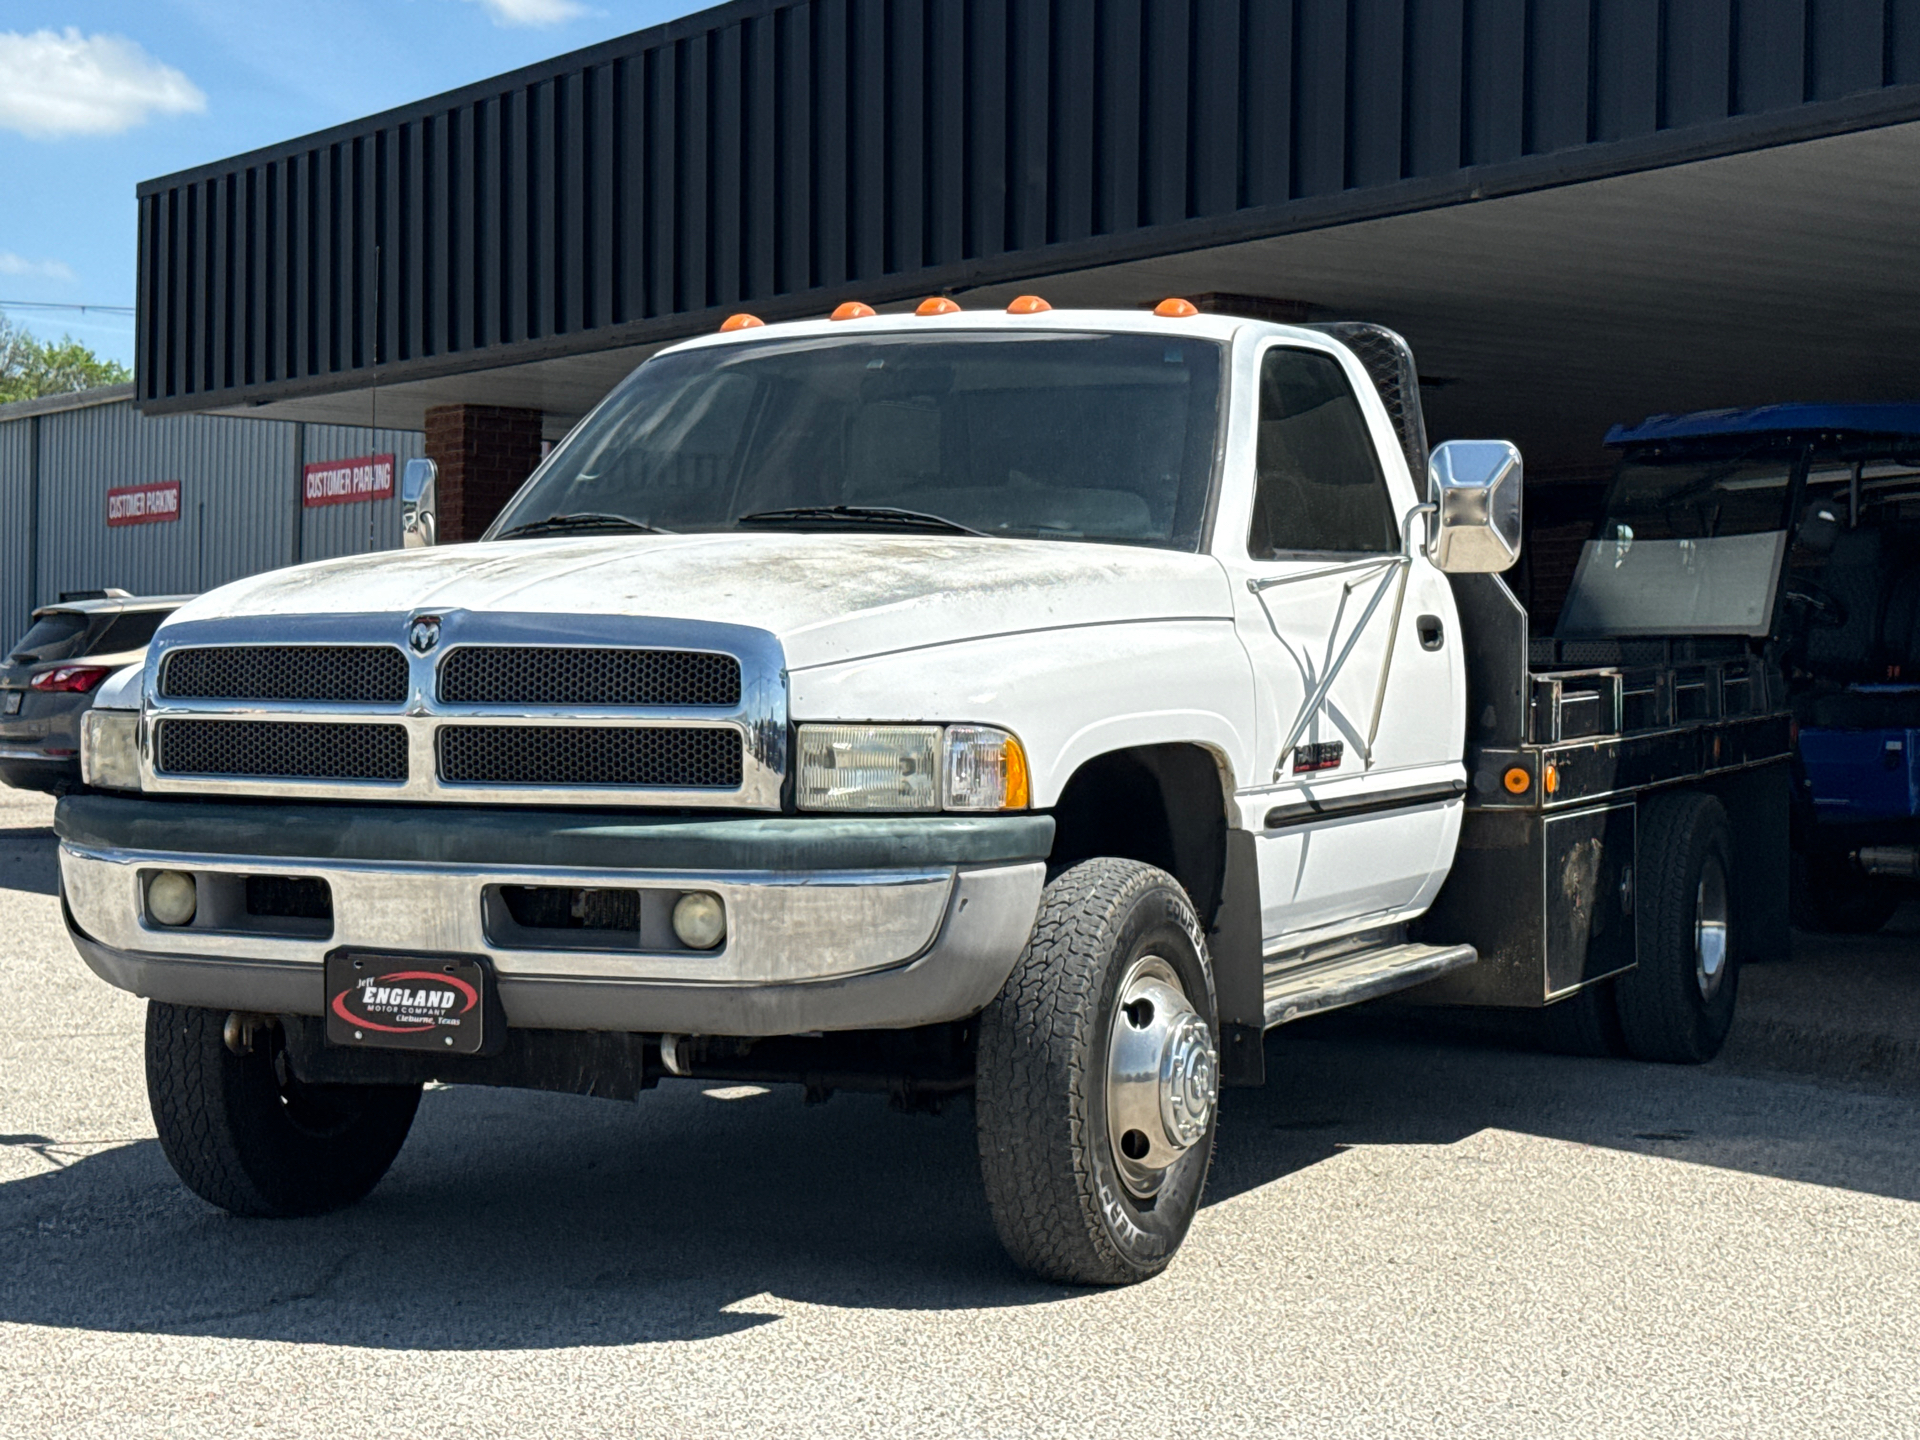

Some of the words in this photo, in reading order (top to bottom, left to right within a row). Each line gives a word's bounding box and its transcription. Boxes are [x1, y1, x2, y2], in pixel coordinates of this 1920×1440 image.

[306, 468, 351, 499] CUSTOMER
[108, 492, 145, 519] CUSTOMER
[146, 488, 178, 515] PARKING
[356, 977, 375, 989] Jeff
[362, 986, 456, 1009] ENGLAND
[367, 1004, 398, 1013] MOTOR
[401, 1006, 446, 1016] COMPANY
[396, 1014, 435, 1025] Cleburne,
[438, 1016, 461, 1026] Texas
